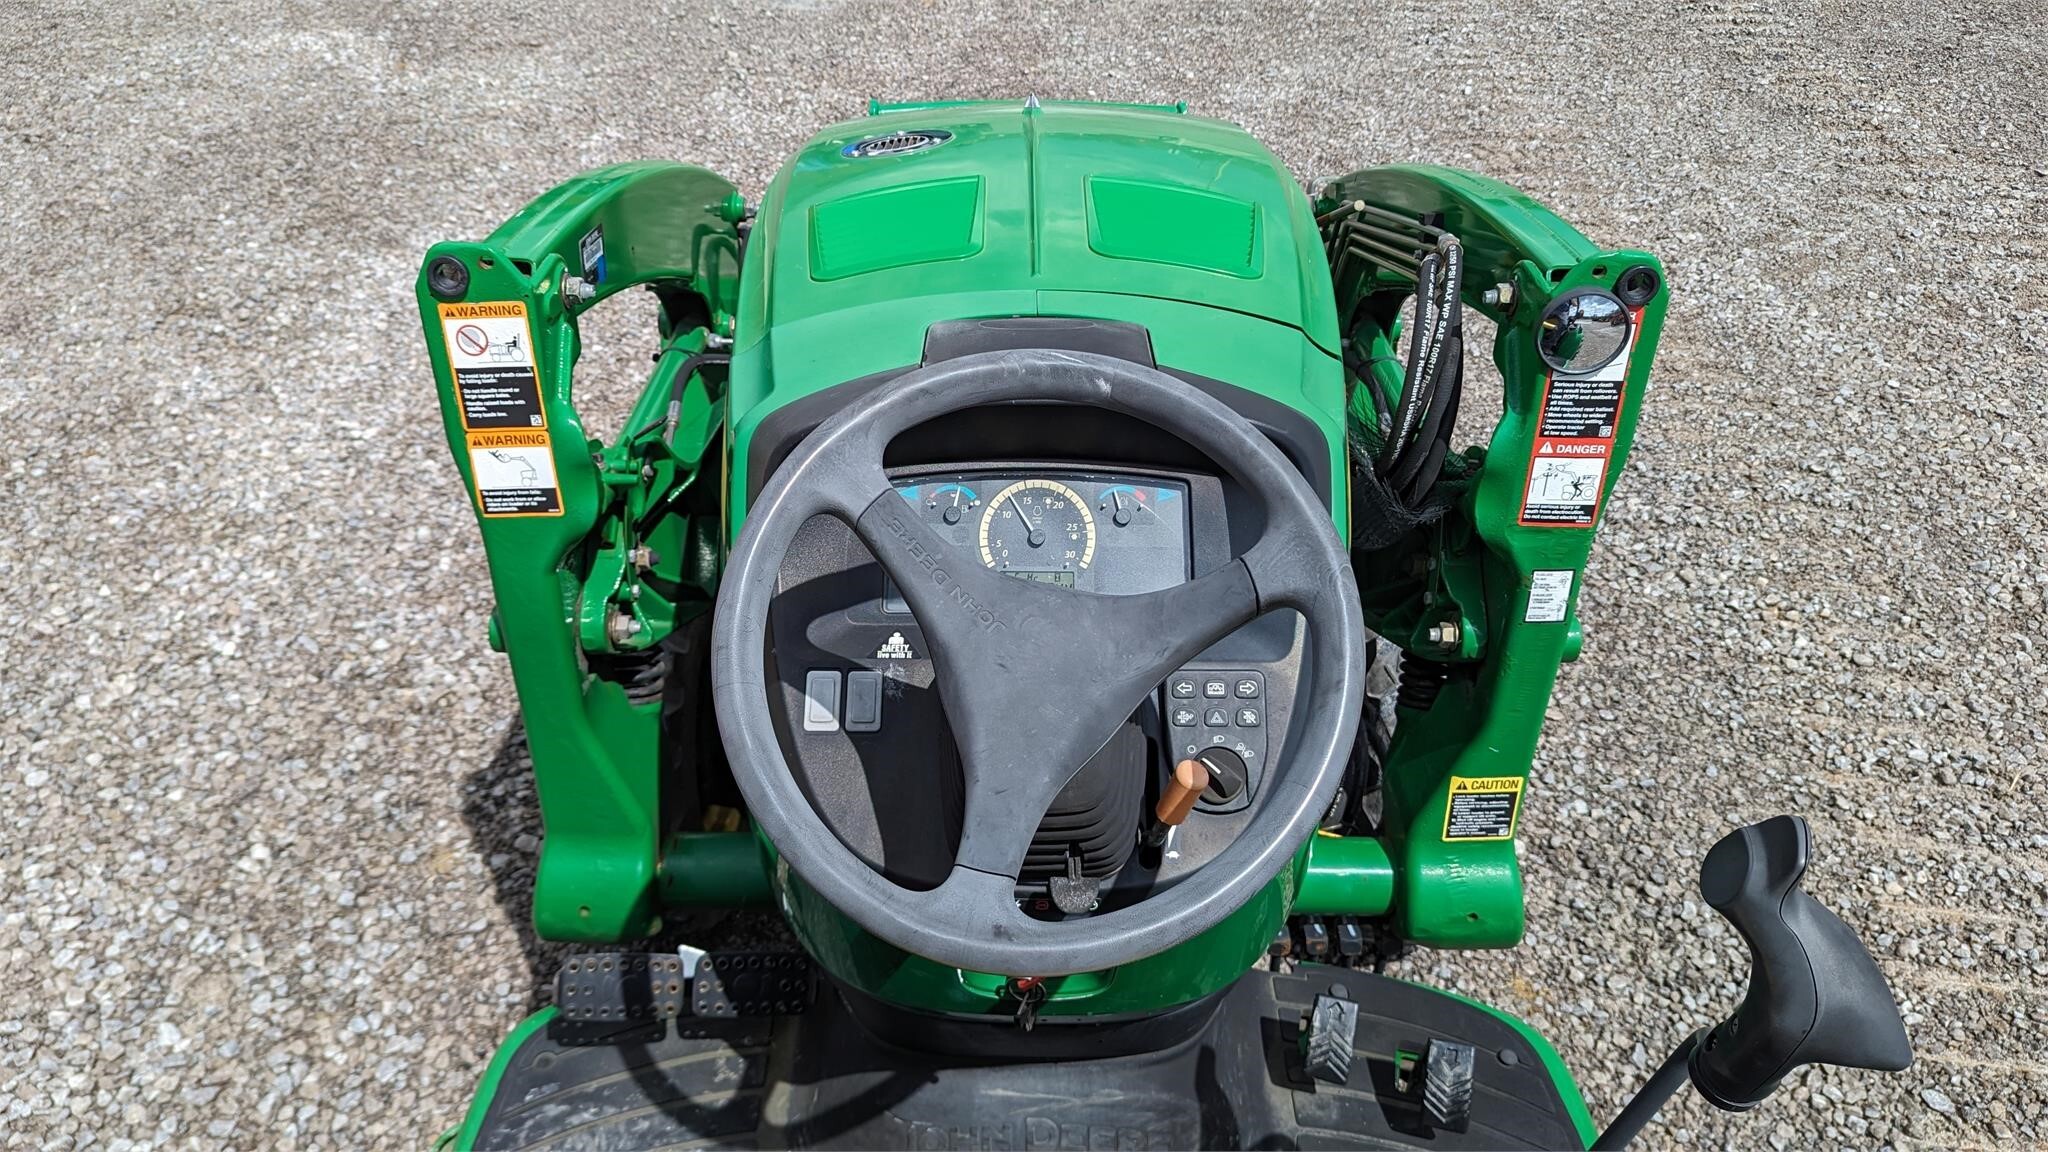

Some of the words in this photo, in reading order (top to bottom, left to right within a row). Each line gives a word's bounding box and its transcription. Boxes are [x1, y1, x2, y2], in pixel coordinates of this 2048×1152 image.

[1448, 266, 1456, 278] PSI
[1444, 280, 1454, 300] MAX
[456, 305, 522, 316] WARNING
[1424, 300, 1433, 329] 100R17
[1442, 302, 1452, 318] WP
[1436, 320, 1447, 340] SAE
[1420, 330, 1430, 358] Flame
[1426, 343, 1441, 374] 100R17
[1410, 360, 1425, 401] Resistant
[483, 435, 546, 446] WARNING
[1556, 444, 1606, 454] DANGER
[950, 585, 1008, 632] JOHN
[882, 644, 910, 652] SAFETY
[1471, 780, 1519, 790] CAUTION
